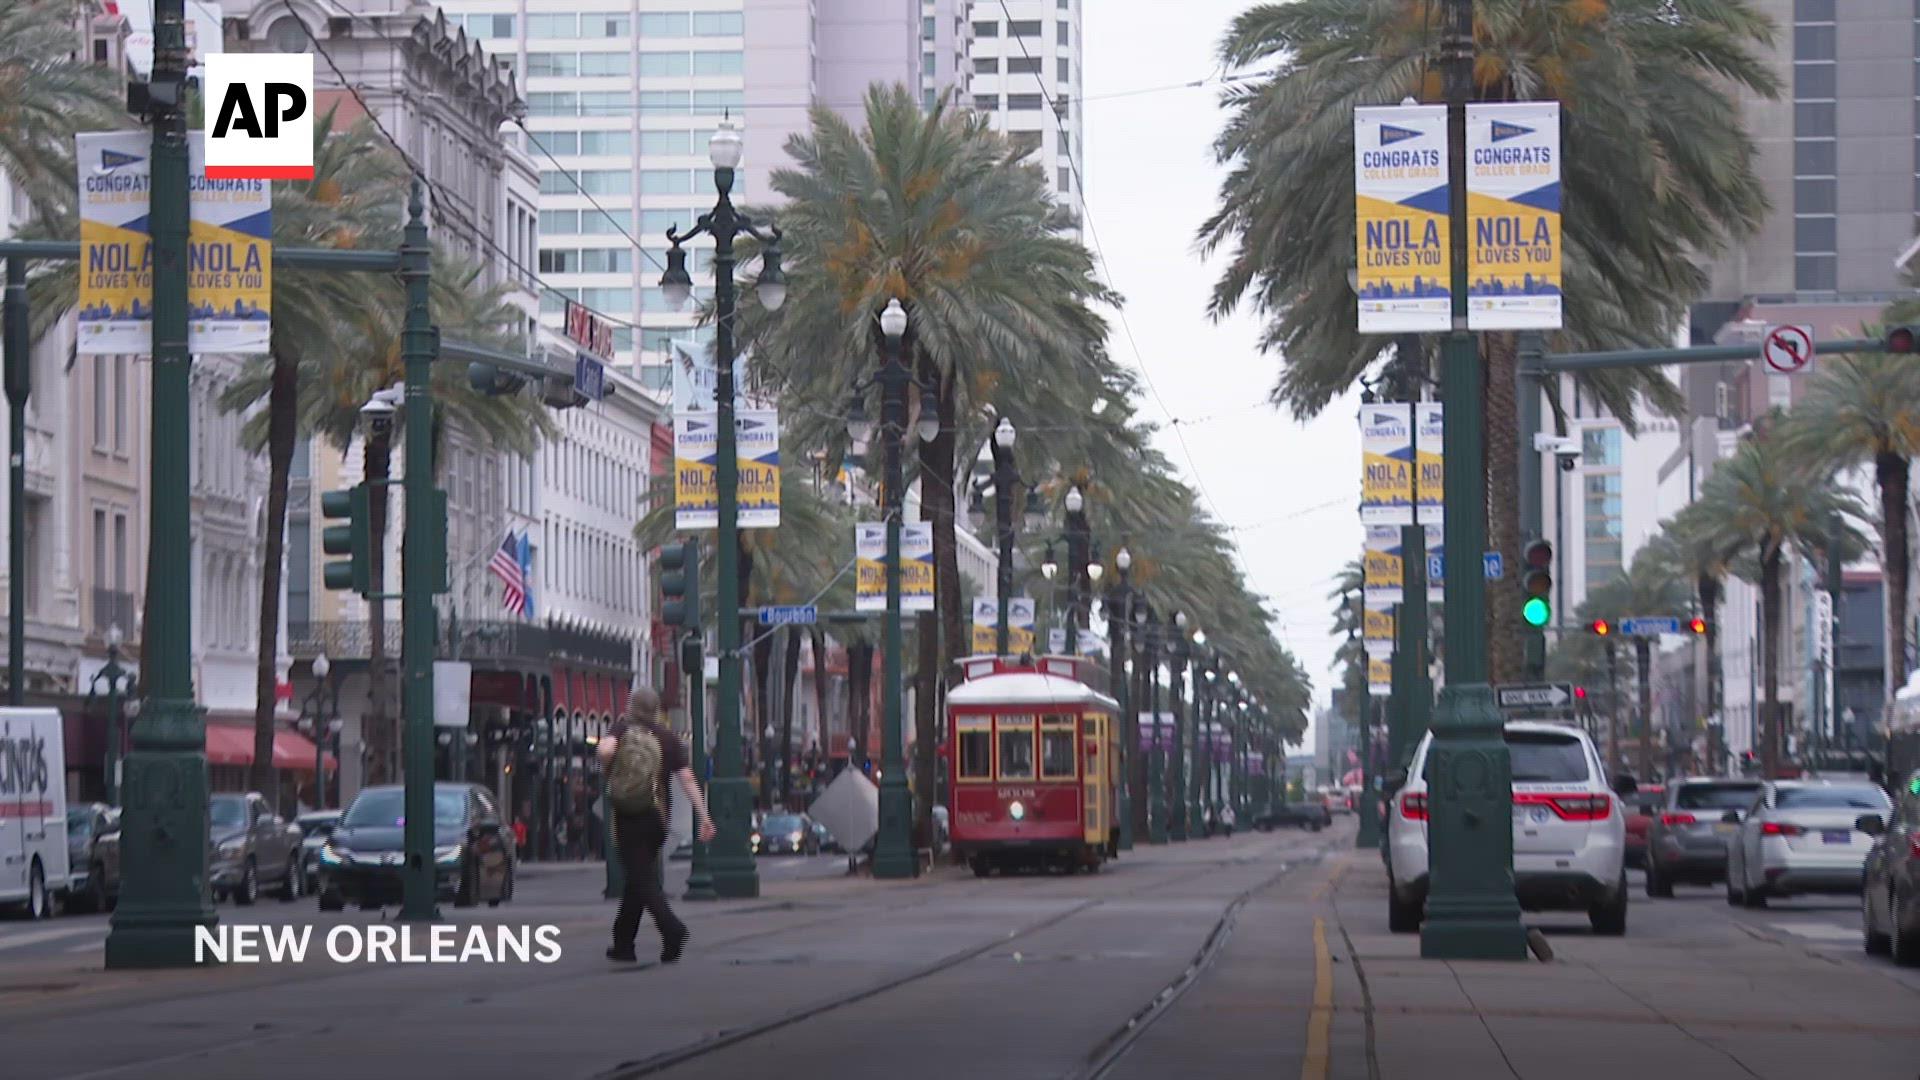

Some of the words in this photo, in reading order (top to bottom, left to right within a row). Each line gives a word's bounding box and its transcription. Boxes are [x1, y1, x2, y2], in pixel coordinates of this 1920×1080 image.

[1363, 150, 1439, 168] CONGRATS
[1474, 147, 1551, 165] CONGRATS
[86, 175, 151, 192] CONGRAT
[1366, 219, 1441, 250] NOLA
[1476, 216, 1552, 248] NOLA
[89, 243, 153, 273] NOLA
[189, 243, 261, 272] NOLA
[1366, 250, 1410, 267] LOVES
[1415, 250, 1441, 265] YOU
[1476, 248, 1520, 264] LOVES
[1525, 247, 1552, 262] YOU
[88, 274, 128, 289] LOVES
[134, 273, 153, 288] YO
[189, 273, 231, 289] LOVES
[236, 273, 262, 289] YOU
[680, 469, 718, 486] NOLA
[737, 468, 775, 485] NOLA
[1367, 464, 1408, 481] NOLA
[1422, 463, 1441, 480] NO
[767, 608, 813, 623] Bourbon
